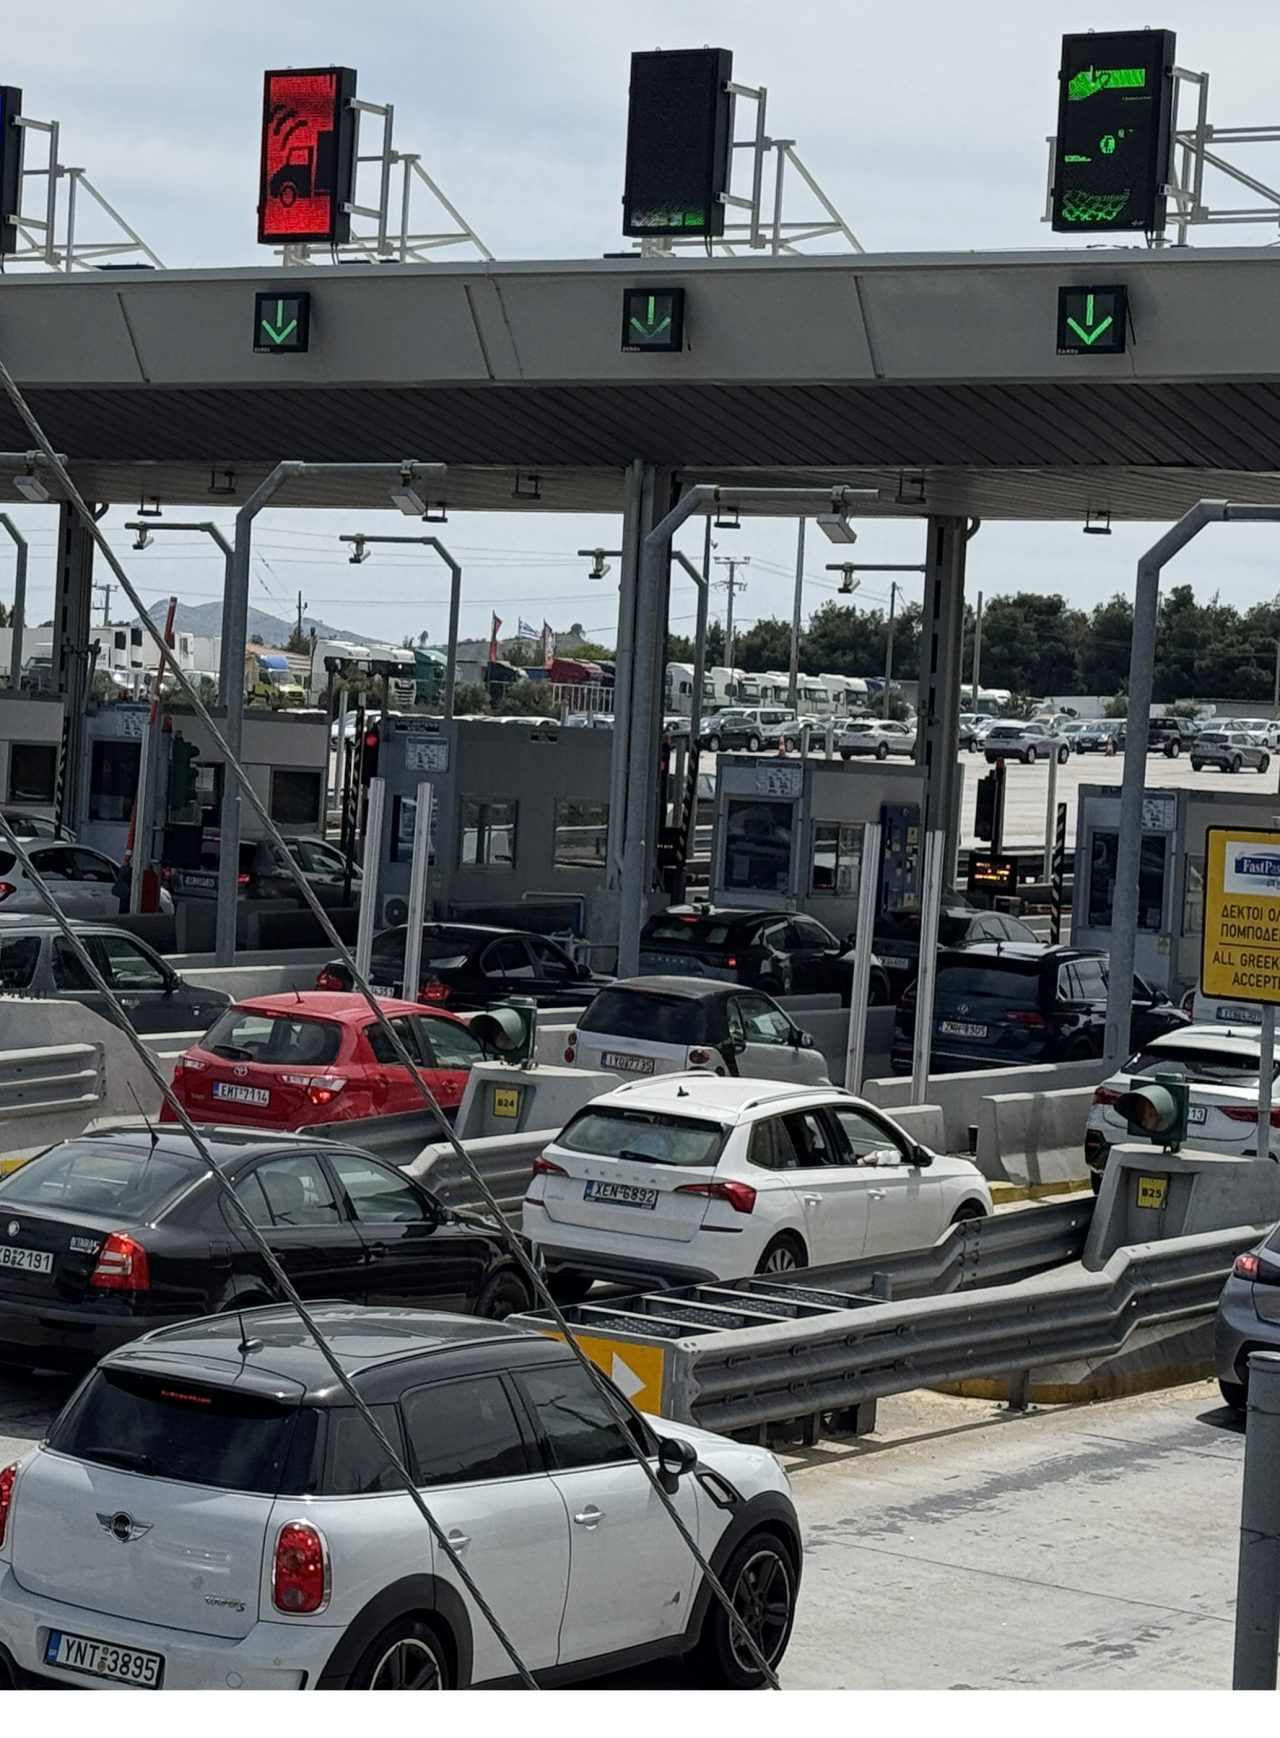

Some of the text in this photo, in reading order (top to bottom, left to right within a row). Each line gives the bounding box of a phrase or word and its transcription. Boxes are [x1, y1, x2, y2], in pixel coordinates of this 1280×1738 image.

[1221, 904, 1263, 921] ΔΕΚΤΟΙ
[1212, 951, 1280, 970] ALL GREEK
[1232, 972, 1280, 989] ACCEPT
[497, 1098, 515, 1108] B24
[1142, 1187, 1162, 1198] B25
